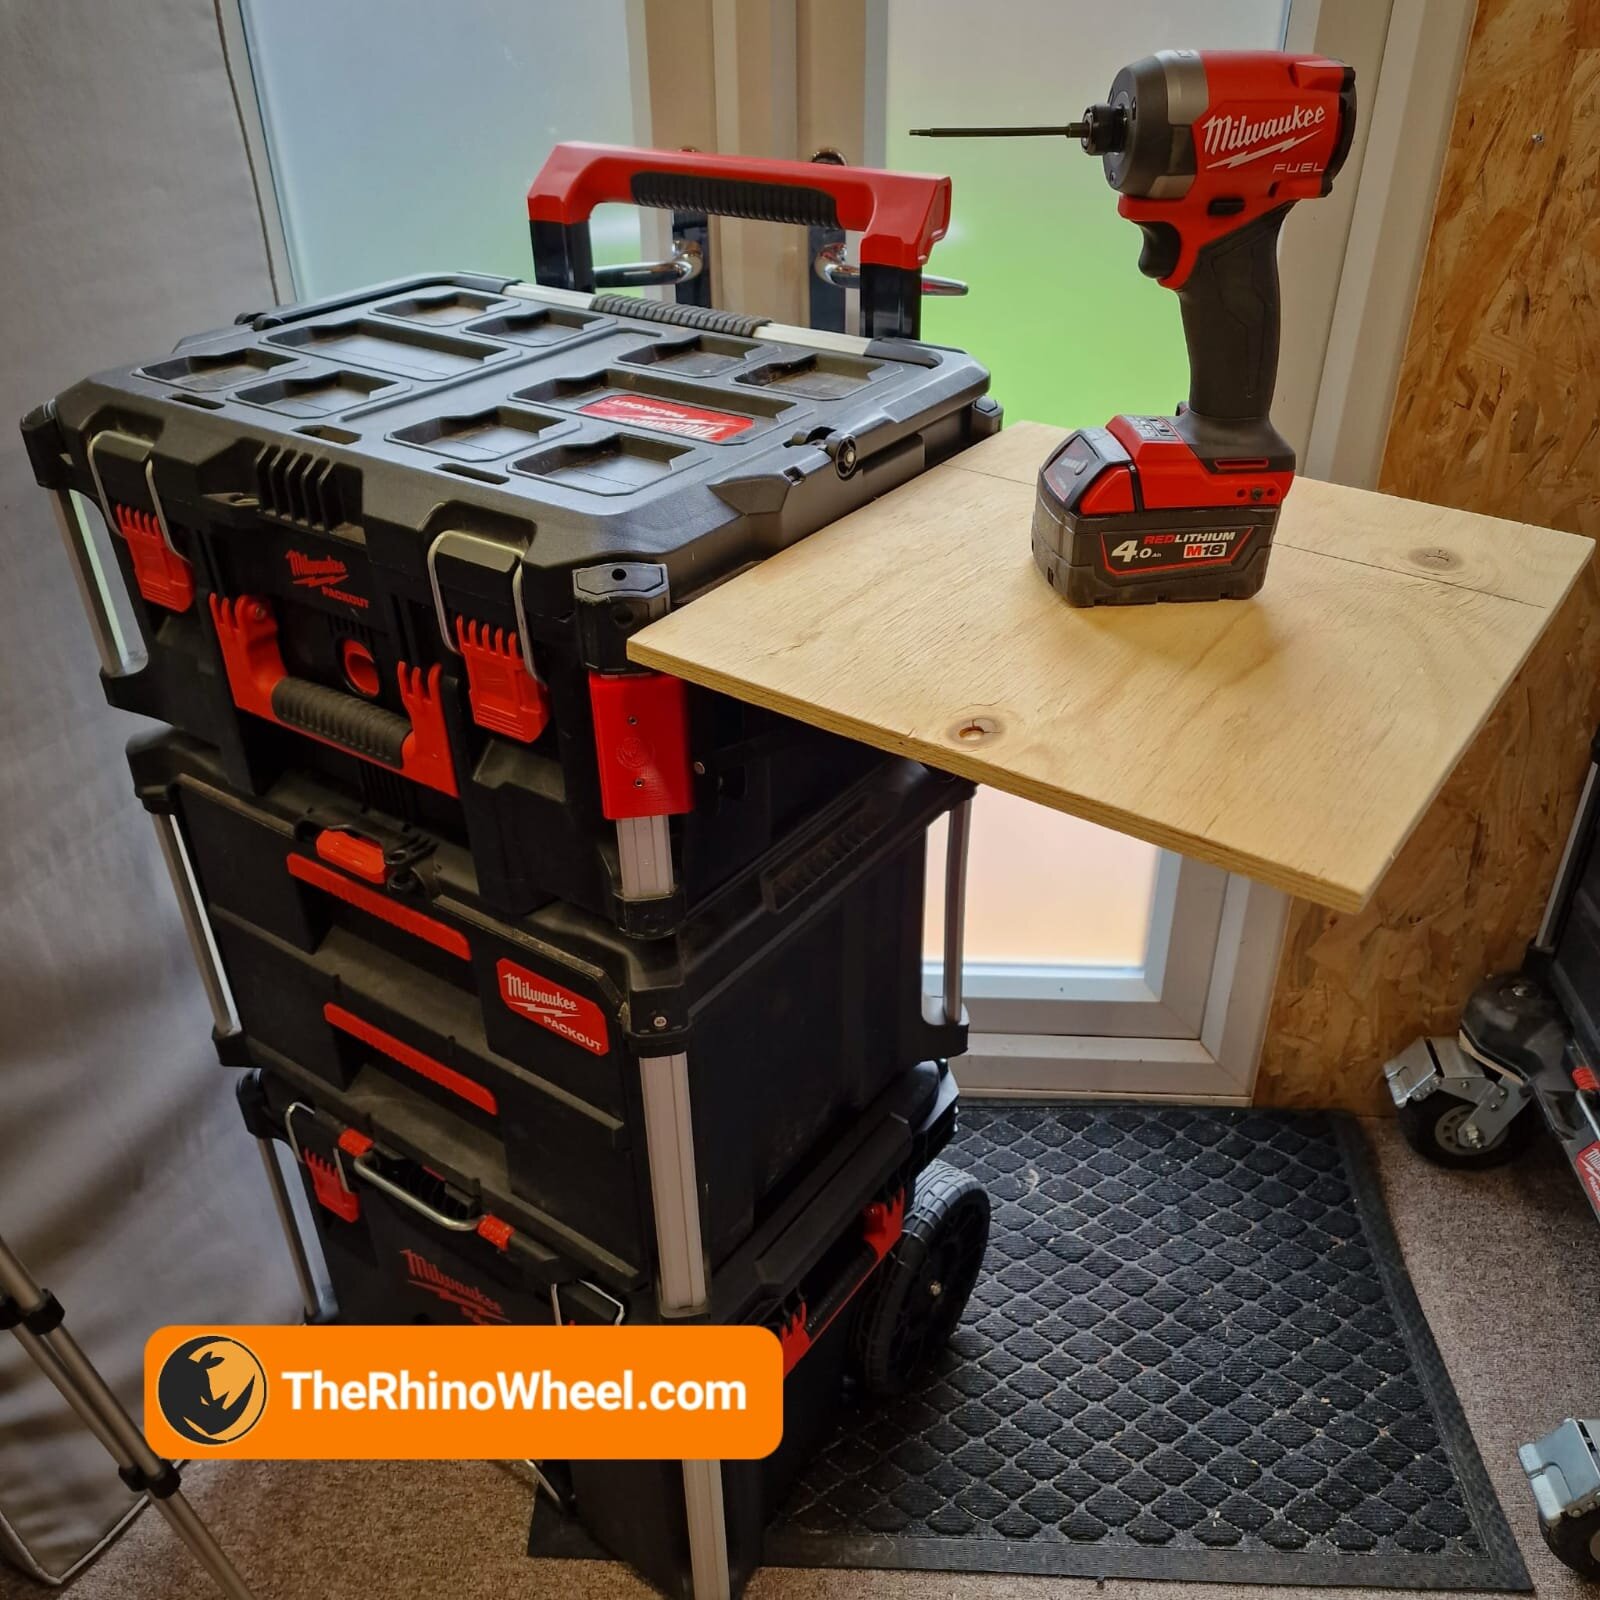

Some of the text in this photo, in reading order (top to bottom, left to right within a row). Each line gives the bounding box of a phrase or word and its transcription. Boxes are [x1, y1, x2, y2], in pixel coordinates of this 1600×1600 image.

[1202, 105, 1325, 155] Milwaukee
[1272, 162, 1324, 174] FUEL
[1144, 532, 1235, 545] REDLITHIUM
[1184, 543, 1226, 558] M18
[502, 973, 578, 1010] Milwaukee
[543, 1015, 602, 1050] PACKOUT
